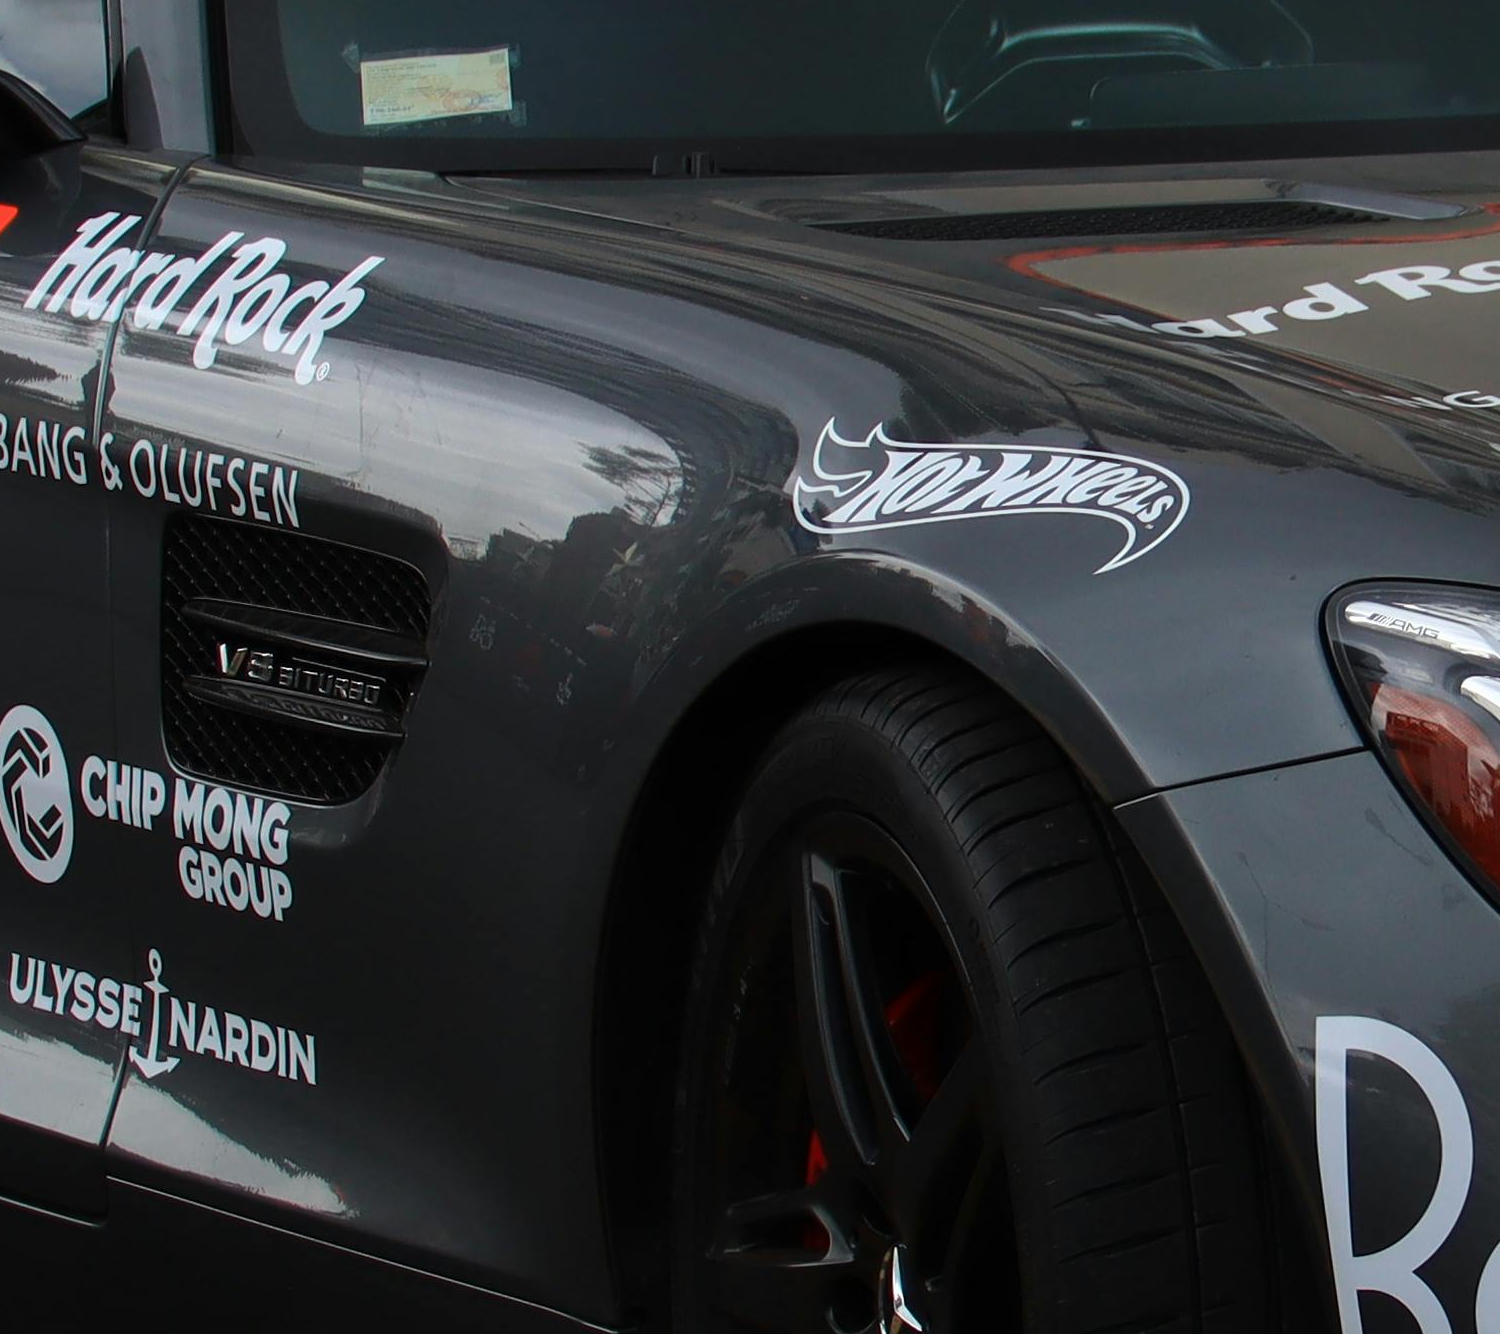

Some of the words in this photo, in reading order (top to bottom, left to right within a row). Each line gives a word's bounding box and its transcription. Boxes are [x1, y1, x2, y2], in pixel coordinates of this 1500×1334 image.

[24, 211, 216, 324] Hard
[188, 233, 384, 385] Rock
[100, 441, 122, 489] &
[128, 443, 298, 529] OLUFSEN
[1389, 619, 1440, 639] AMG
[215, 643, 274, 683] V8
[278, 666, 381, 705] BITURBO
[80, 756, 165, 830] CHIP
[173, 785, 291, 865] MONG
[177, 845, 294, 922] GROUP
[10, 953, 143, 1035] ULYSSE
[169, 994, 317, 1086] NARDIN
